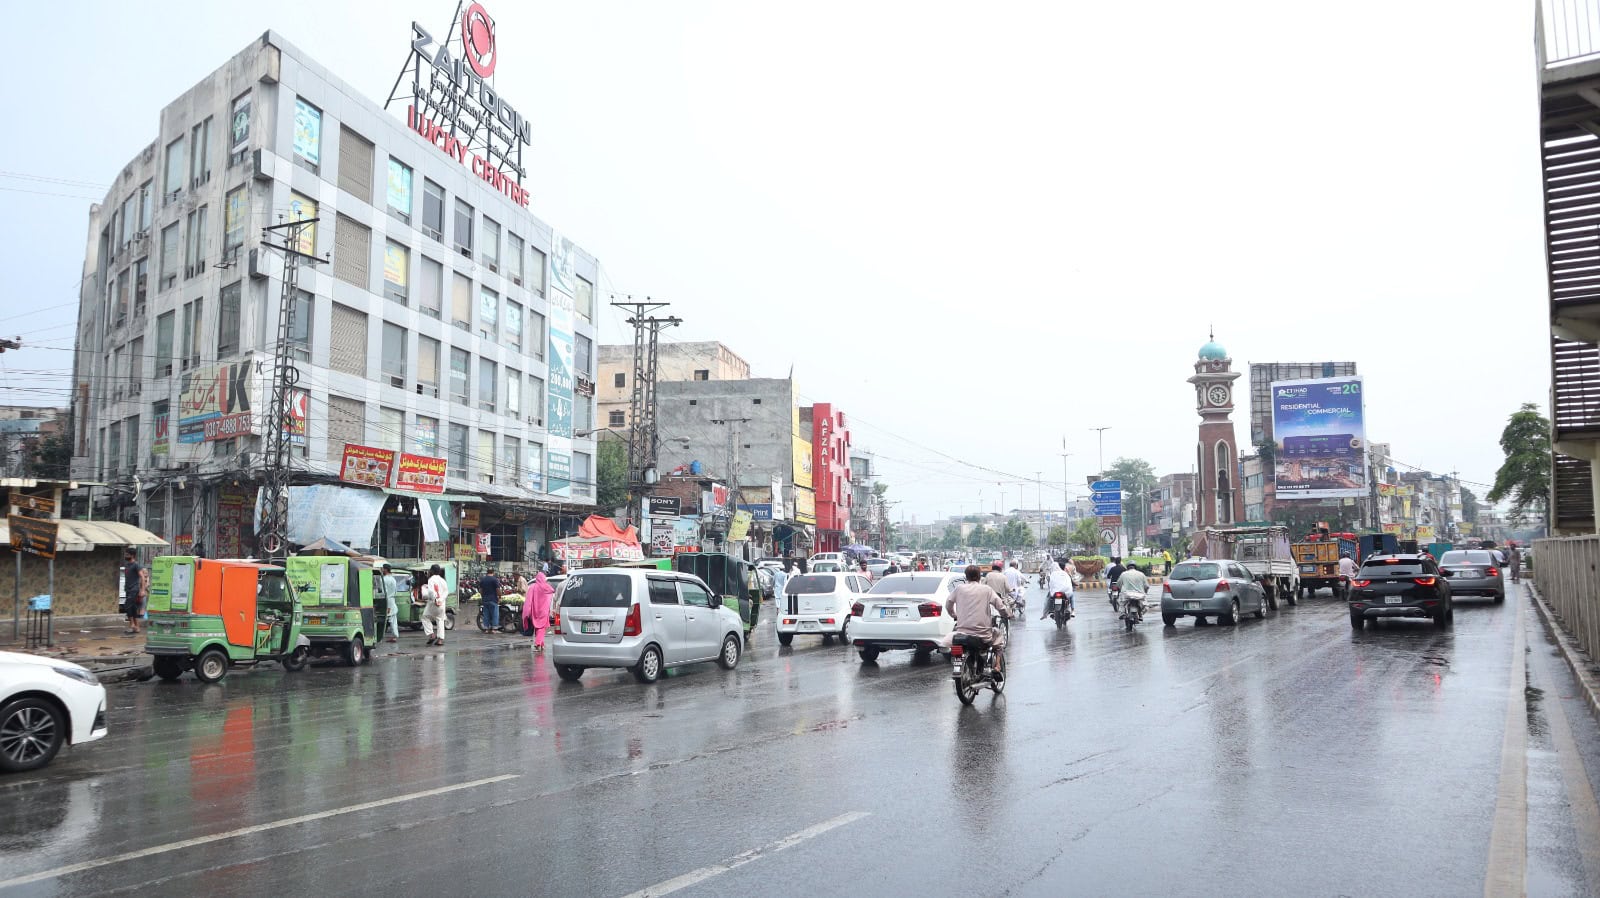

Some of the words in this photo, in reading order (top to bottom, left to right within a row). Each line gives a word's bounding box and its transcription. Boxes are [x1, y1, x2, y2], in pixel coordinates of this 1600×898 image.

[411, 20, 531, 146] ZAITOON
[408, 105, 469, 164] LUCKY
[472, 155, 530, 208] CENTRE
[753, 509, 768, 517] Print
